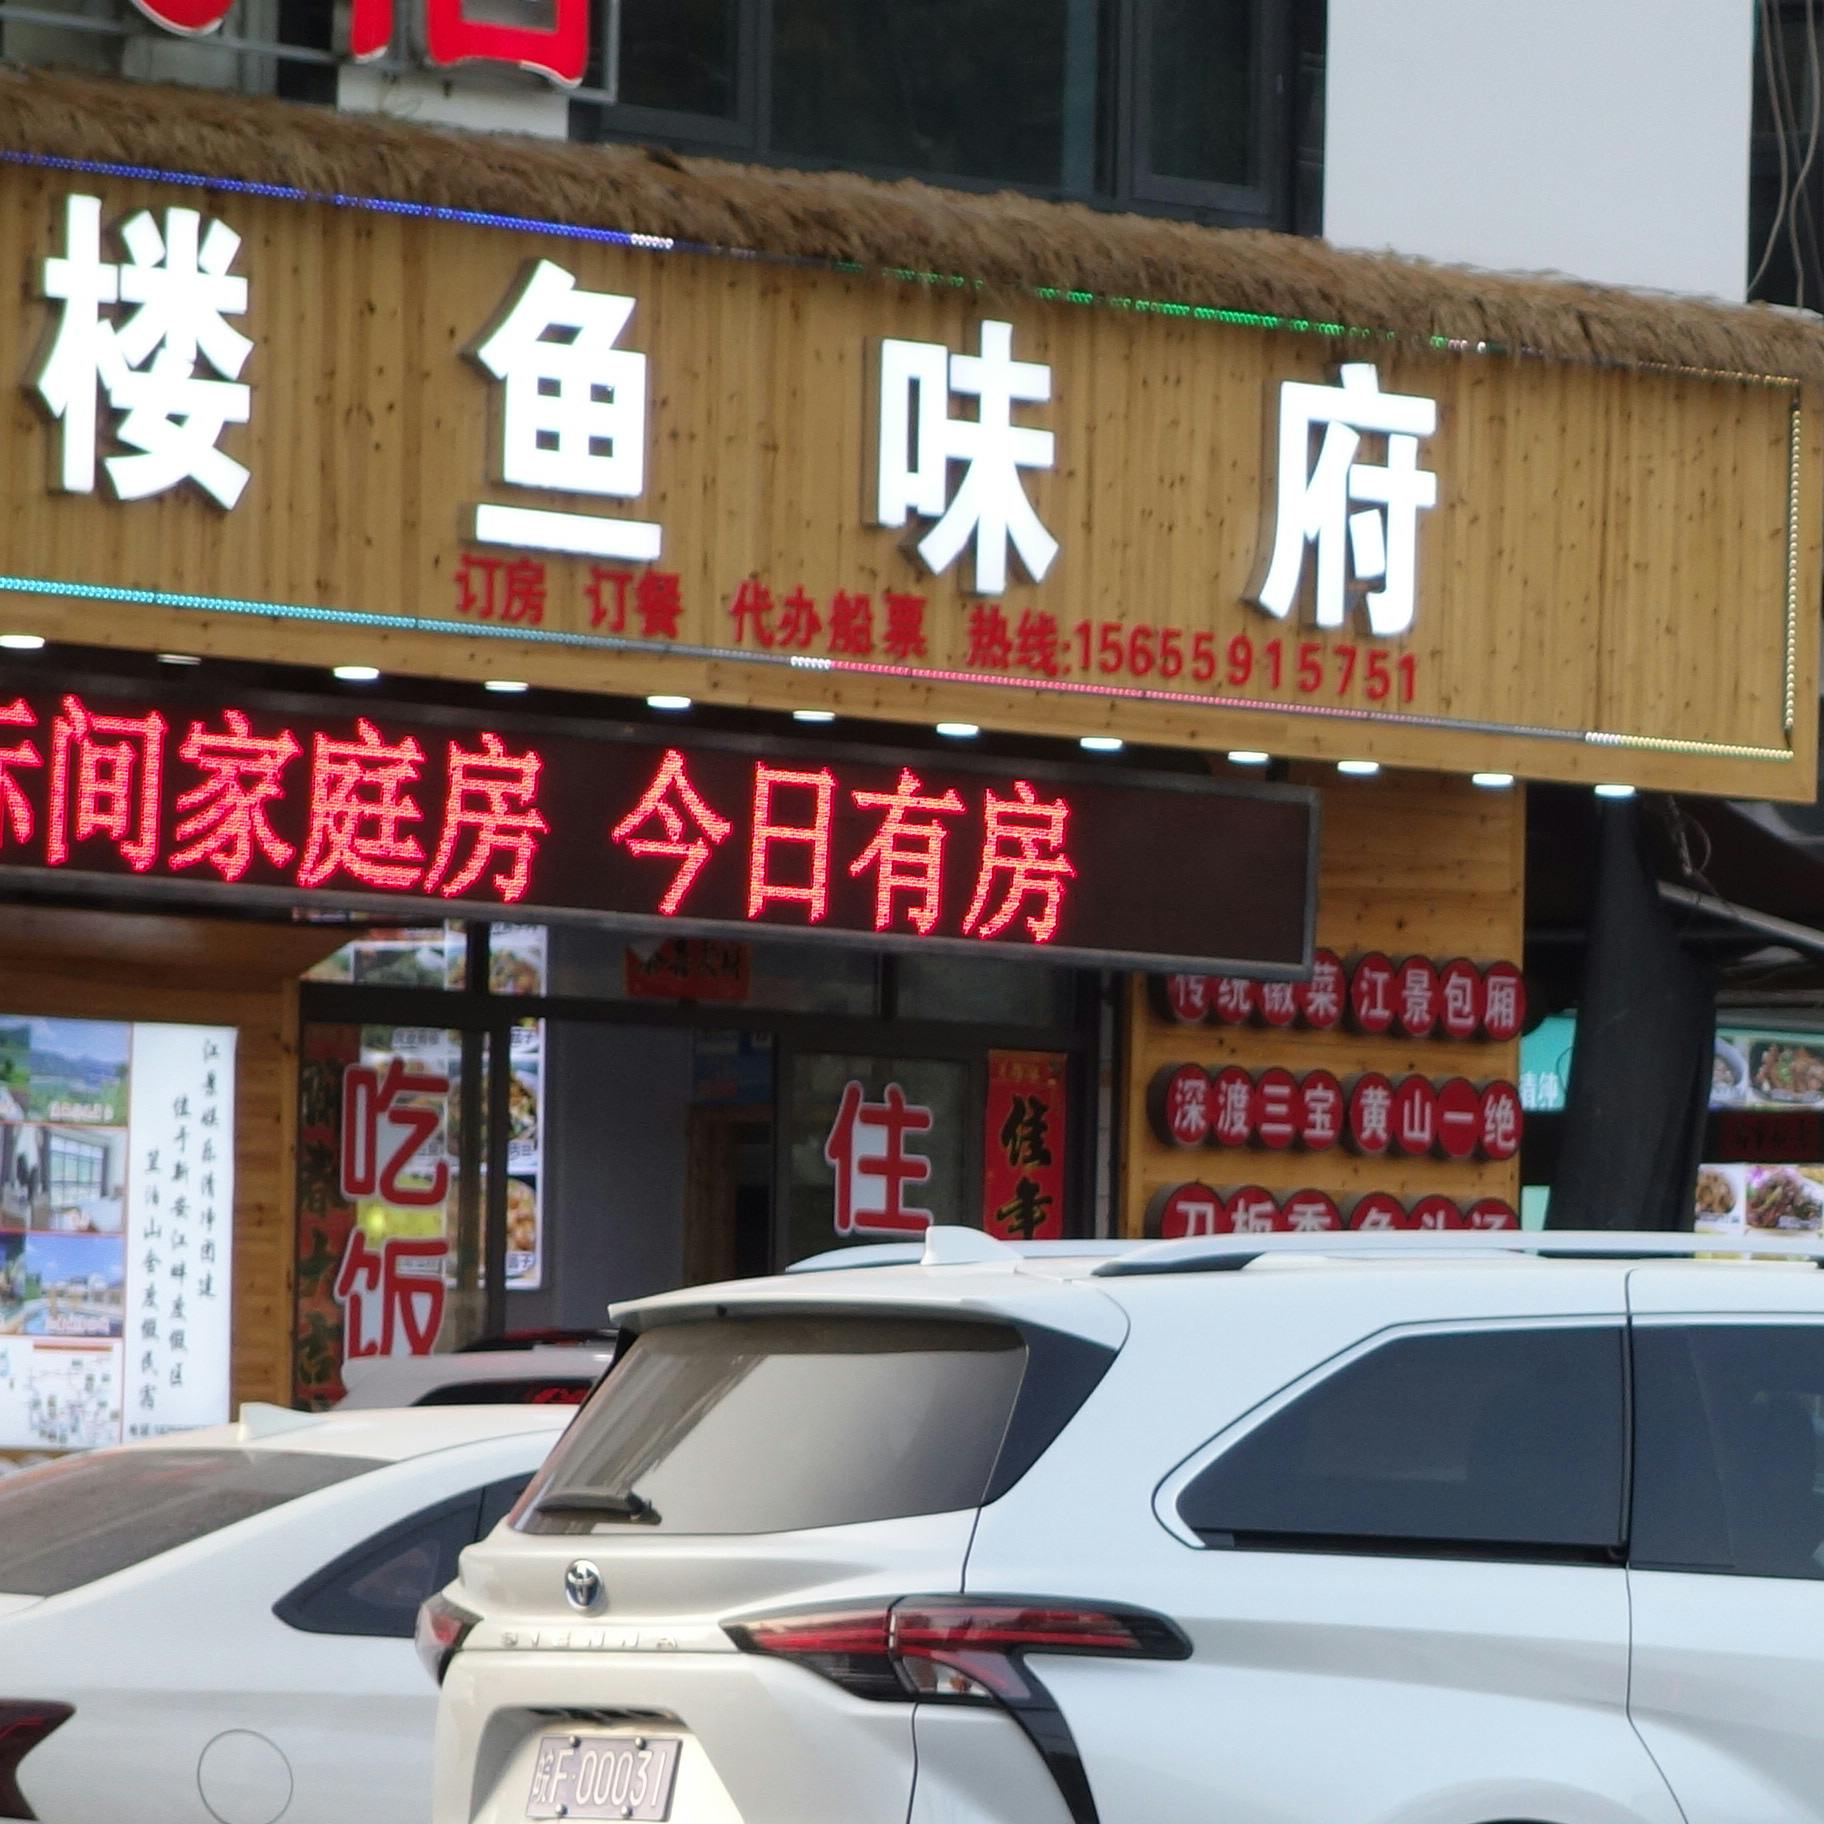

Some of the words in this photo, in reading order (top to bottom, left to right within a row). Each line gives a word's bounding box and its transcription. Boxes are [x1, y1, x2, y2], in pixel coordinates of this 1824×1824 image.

[456, 555, 546, 626] 订房
[586, 565, 684, 640] 订餐
[731, 580, 928, 661] 代办船票
[611, 749, 1077, 944] 今日有房
[1360, 966, 1516, 1028] 江景包厢
[826, 1081, 933, 1233] 住
[1174, 1077, 1335, 1139] 深渡三宝
[1360, 1085, 1516, 1150] 黄山一绝
[341, 1057, 449, 1358] 吃饭
